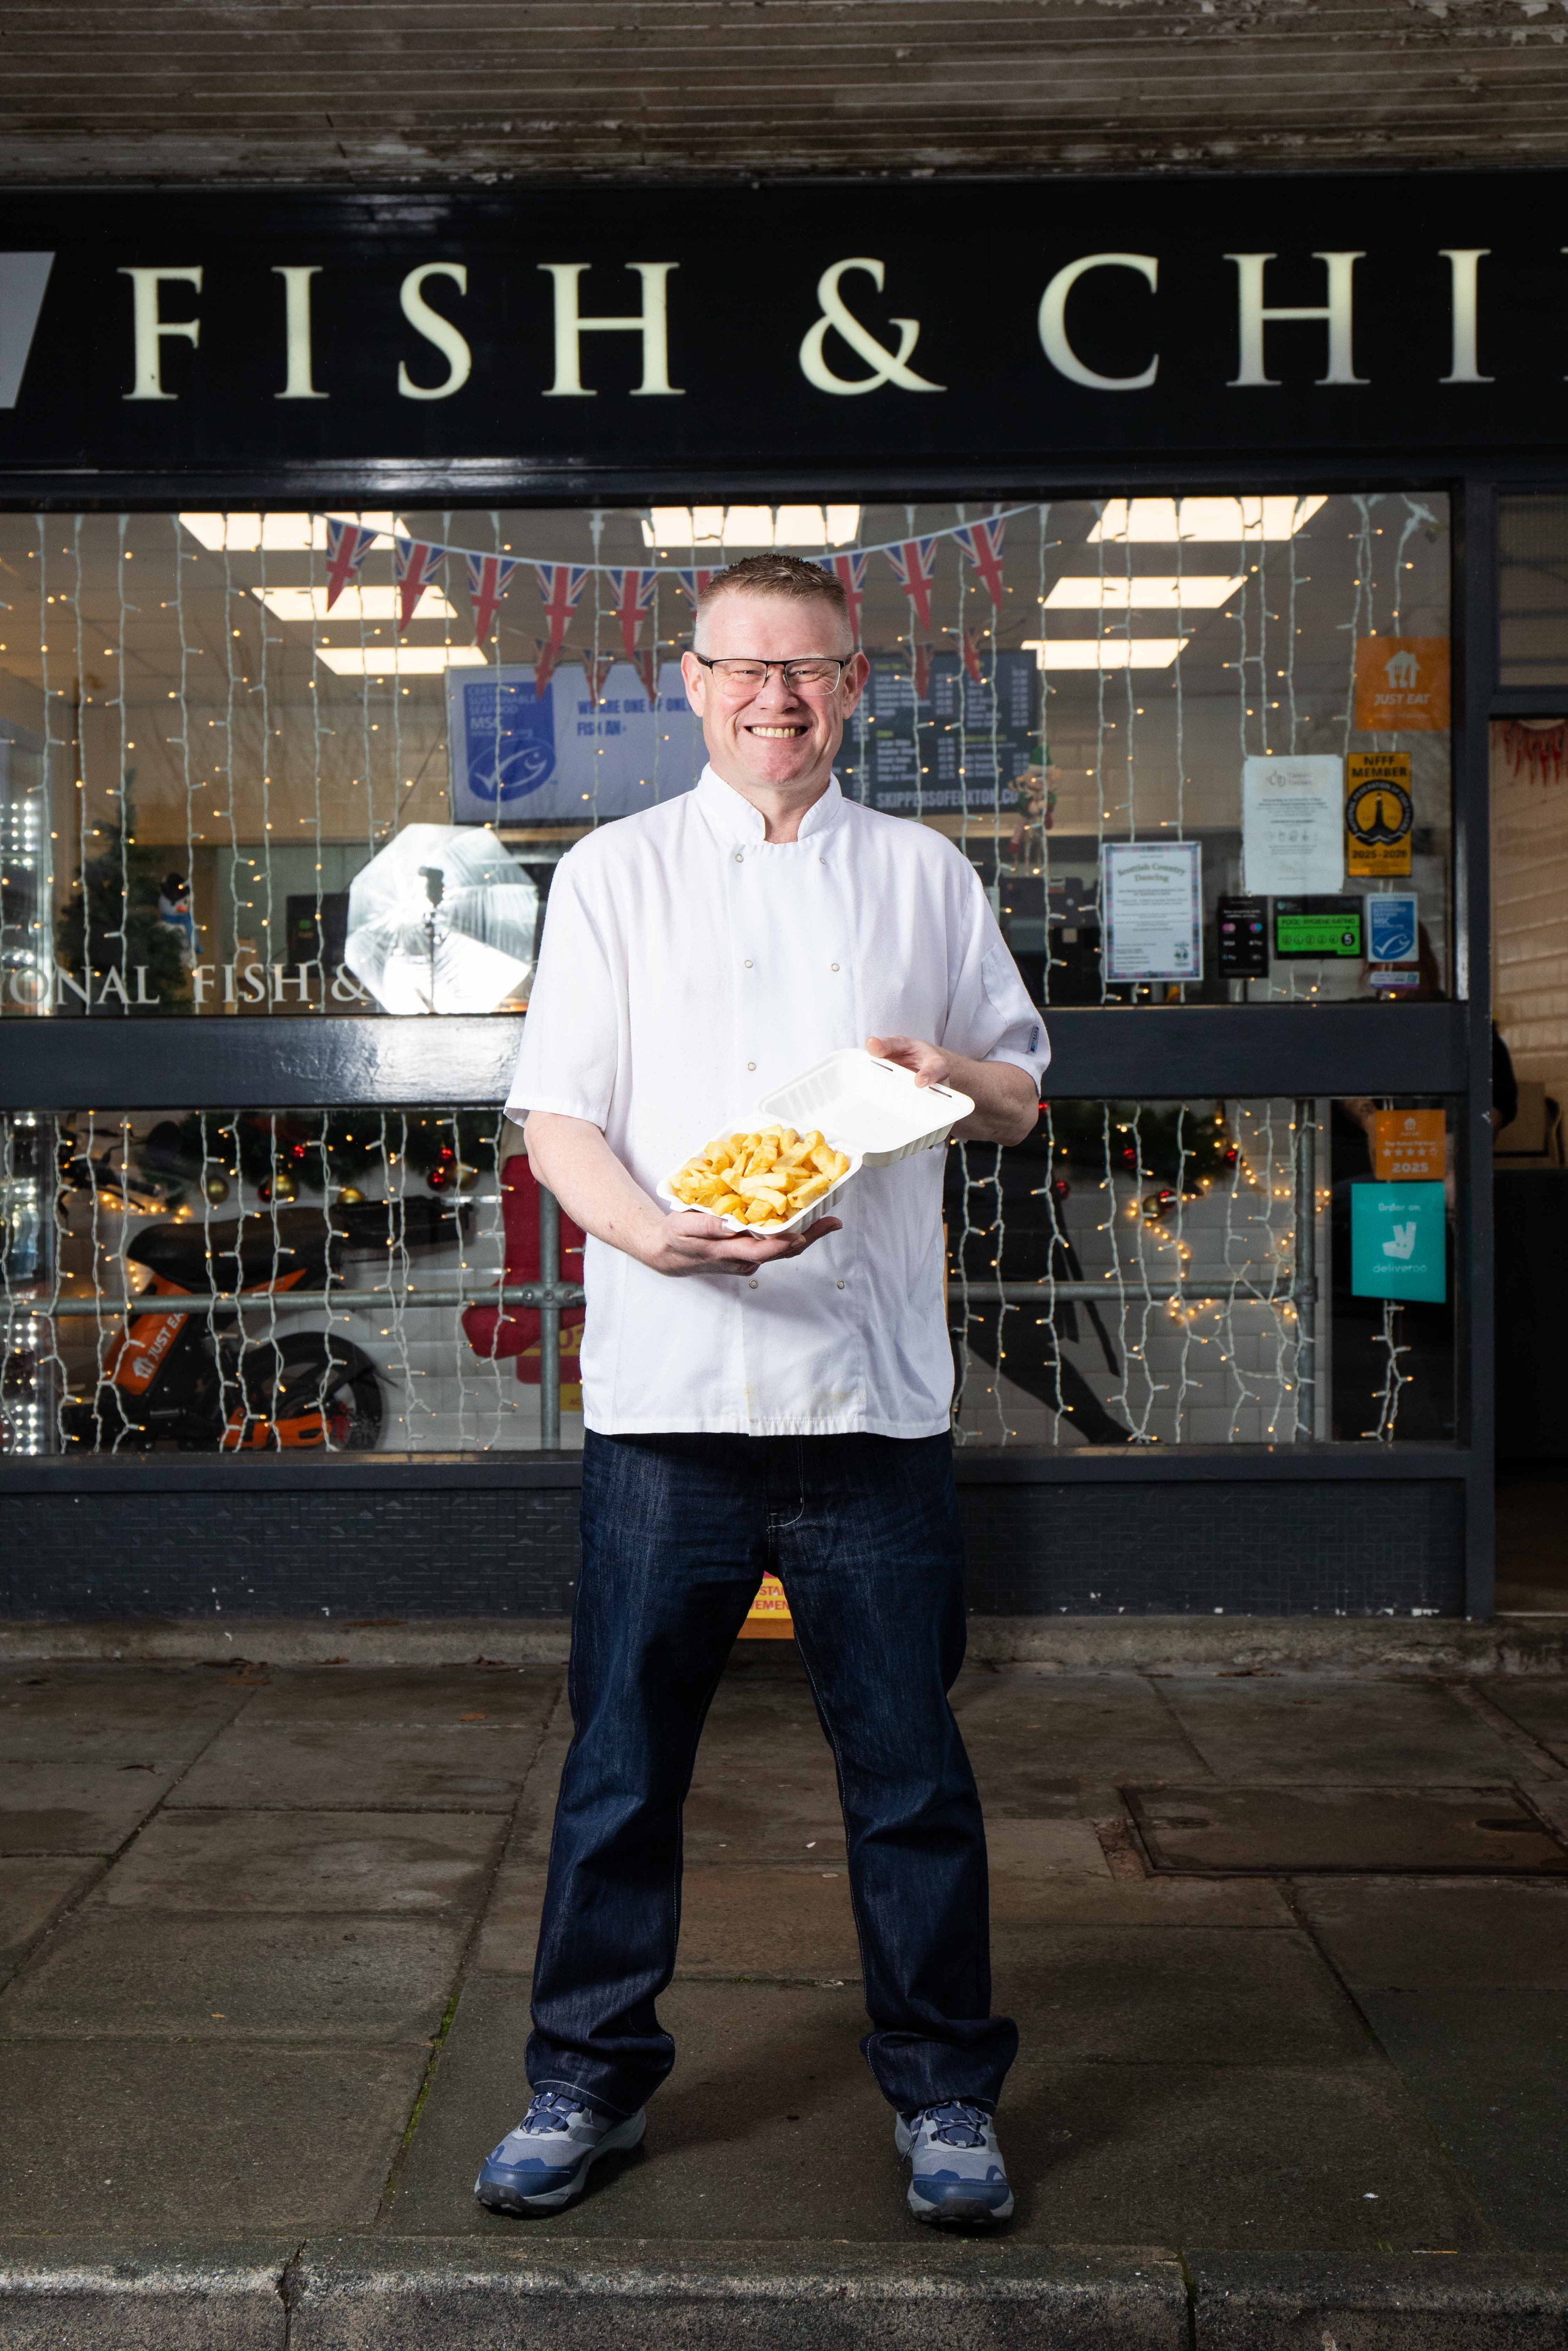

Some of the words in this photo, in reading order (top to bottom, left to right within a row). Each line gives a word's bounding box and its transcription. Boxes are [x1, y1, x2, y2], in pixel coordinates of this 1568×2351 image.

[117, 262, 686, 400] FISH
[799, 257, 947, 395] &
[1037, 247, 1568, 391] CHI
[1374, 694, 1404, 705] JUST
[1407, 694, 1430, 705] EAT
[1364, 756, 1396, 765] NFFF
[1352, 768, 1408, 778] MEMBER
[1352, 850, 1378, 859] 2025
[1383, 849, 1408, 859] 2026
[1117, 863, 1150, 876] Scottish
[1152, 863, 1186, 876] Country
[1135, 874, 1169, 882] Dancing
[1345, 934, 1352, 945] 5
[193, 963, 313, 1003] FISH
[1392, 1162, 1429, 1173] 2025
[1378, 1203, 1405, 1212] Order
[1373, 1264, 1428, 1273] deliveroo
[147, 1326, 172, 1361] JUST
